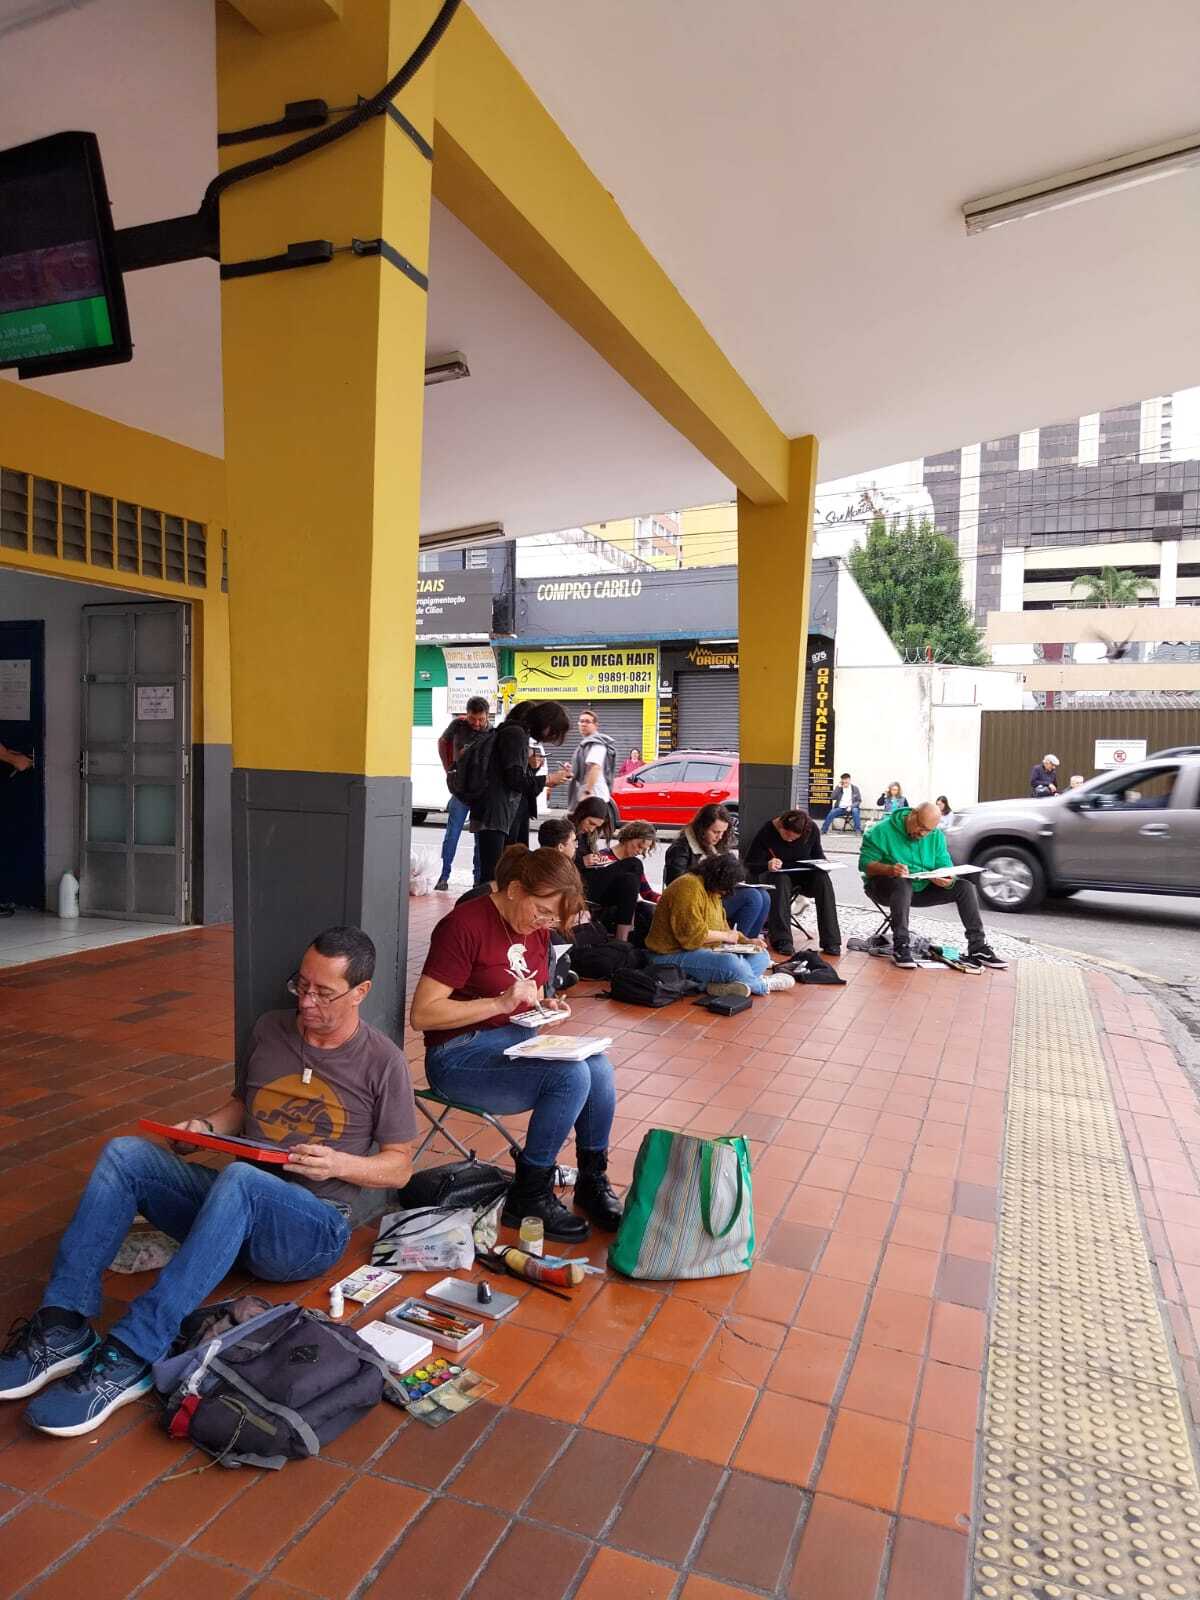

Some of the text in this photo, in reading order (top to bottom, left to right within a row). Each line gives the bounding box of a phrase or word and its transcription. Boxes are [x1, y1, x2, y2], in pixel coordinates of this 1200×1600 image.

[537, 578, 642, 601] COMPRO CABELO
[551, 652, 655, 667] CIA DO MEGA HAIR
[696, 655, 738, 666] ORIGIN
[598, 671, 652, 683] 99891-0821
[597, 683, 651, 695] cia.megahair
